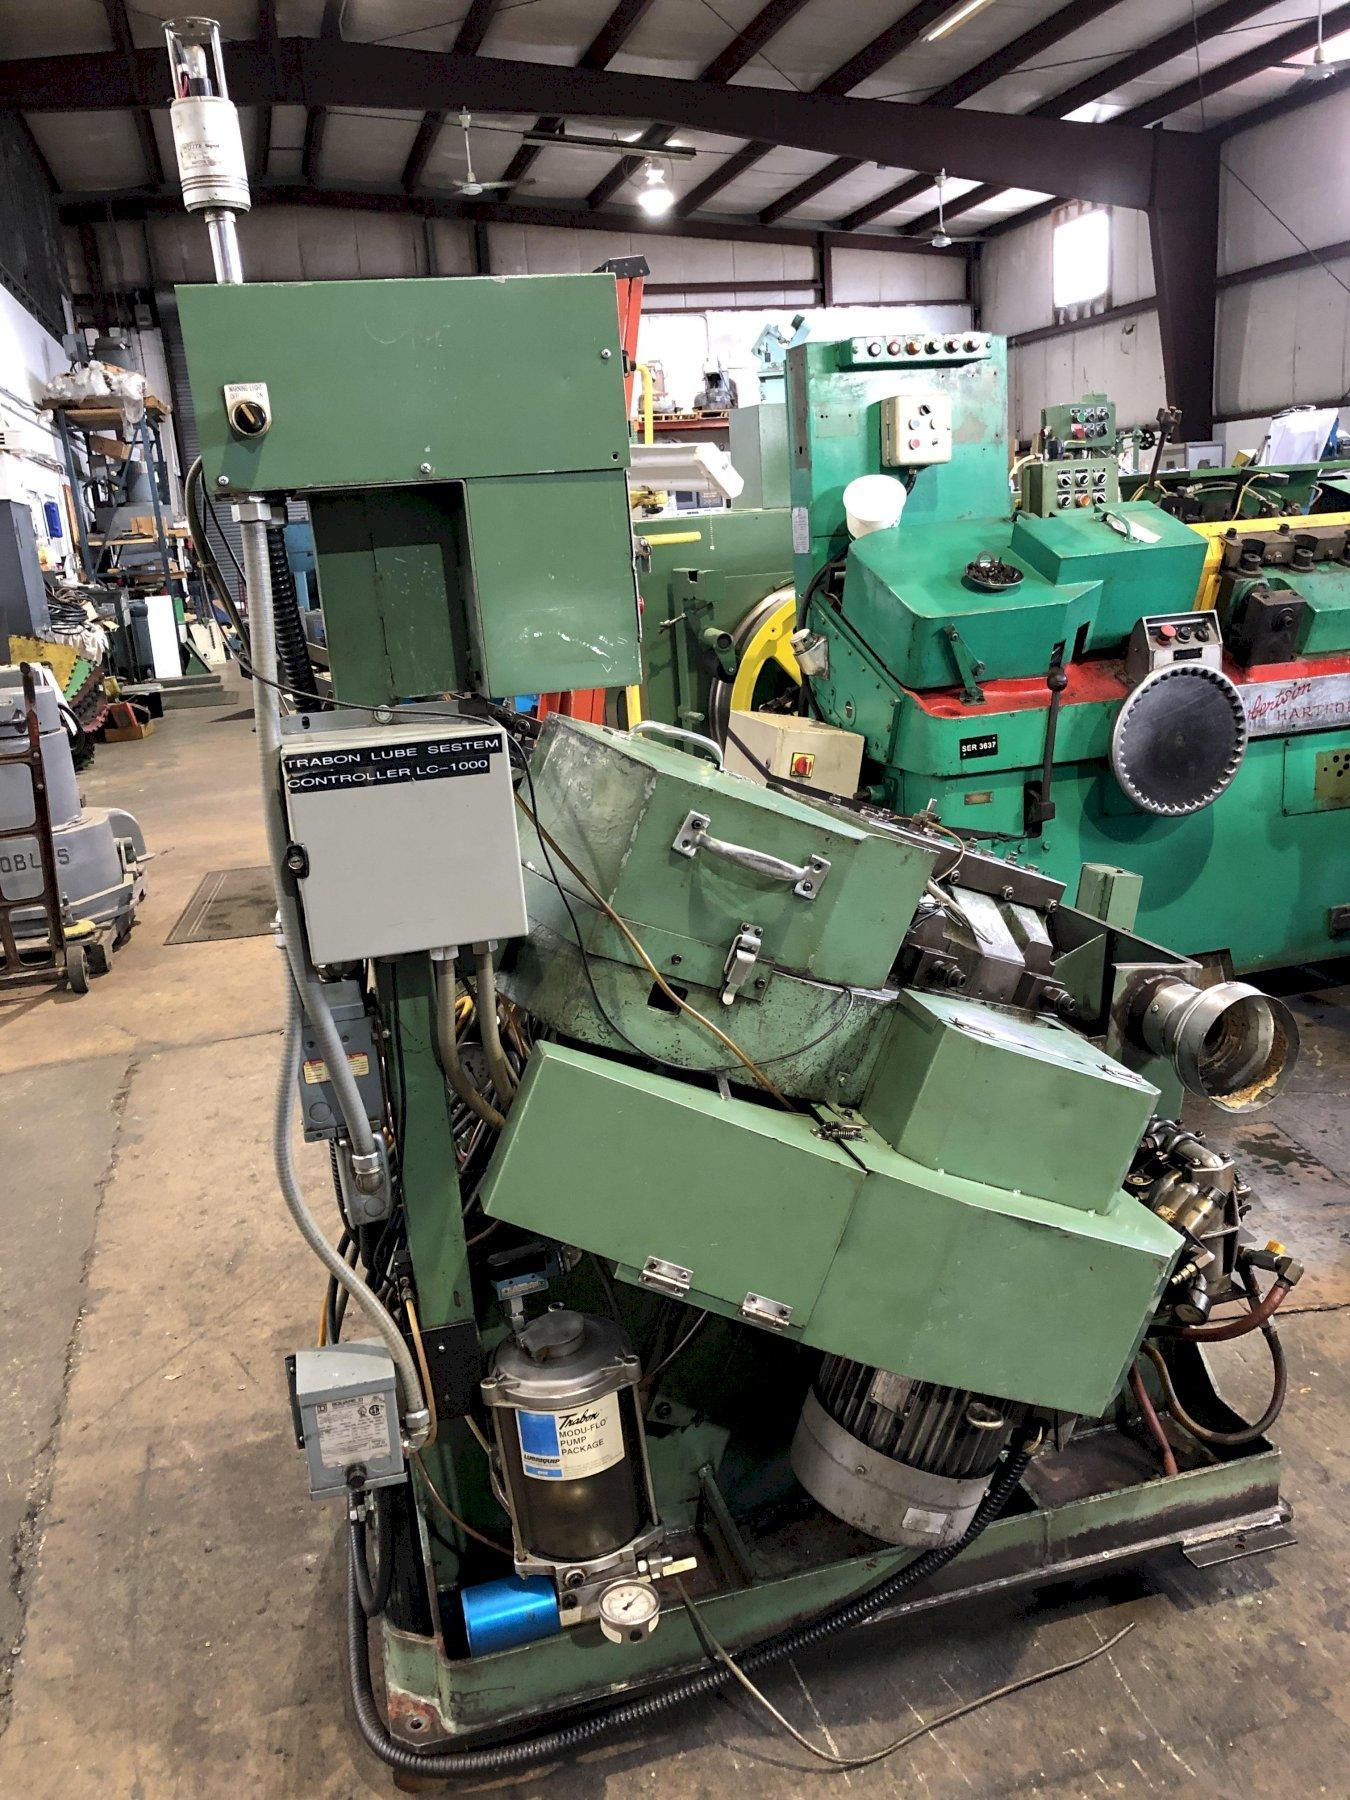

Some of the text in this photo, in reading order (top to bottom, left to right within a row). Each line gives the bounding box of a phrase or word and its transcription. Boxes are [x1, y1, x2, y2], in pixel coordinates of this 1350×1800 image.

[1277, 701, 1350, 720] HARTFO
[286, 739, 499, 768] TRABON LUBE SESTEM
[961, 741, 996, 752] SER 3637
[287, 759, 488, 788] CONTROLLER LC-1000
[559, 1409, 600, 1430] Trabon
[559, 1418, 607, 1438] MODU-FLO
[560, 1436, 587, 1447] PUMP
[561, 1439, 605, 1456] PACKAGE
